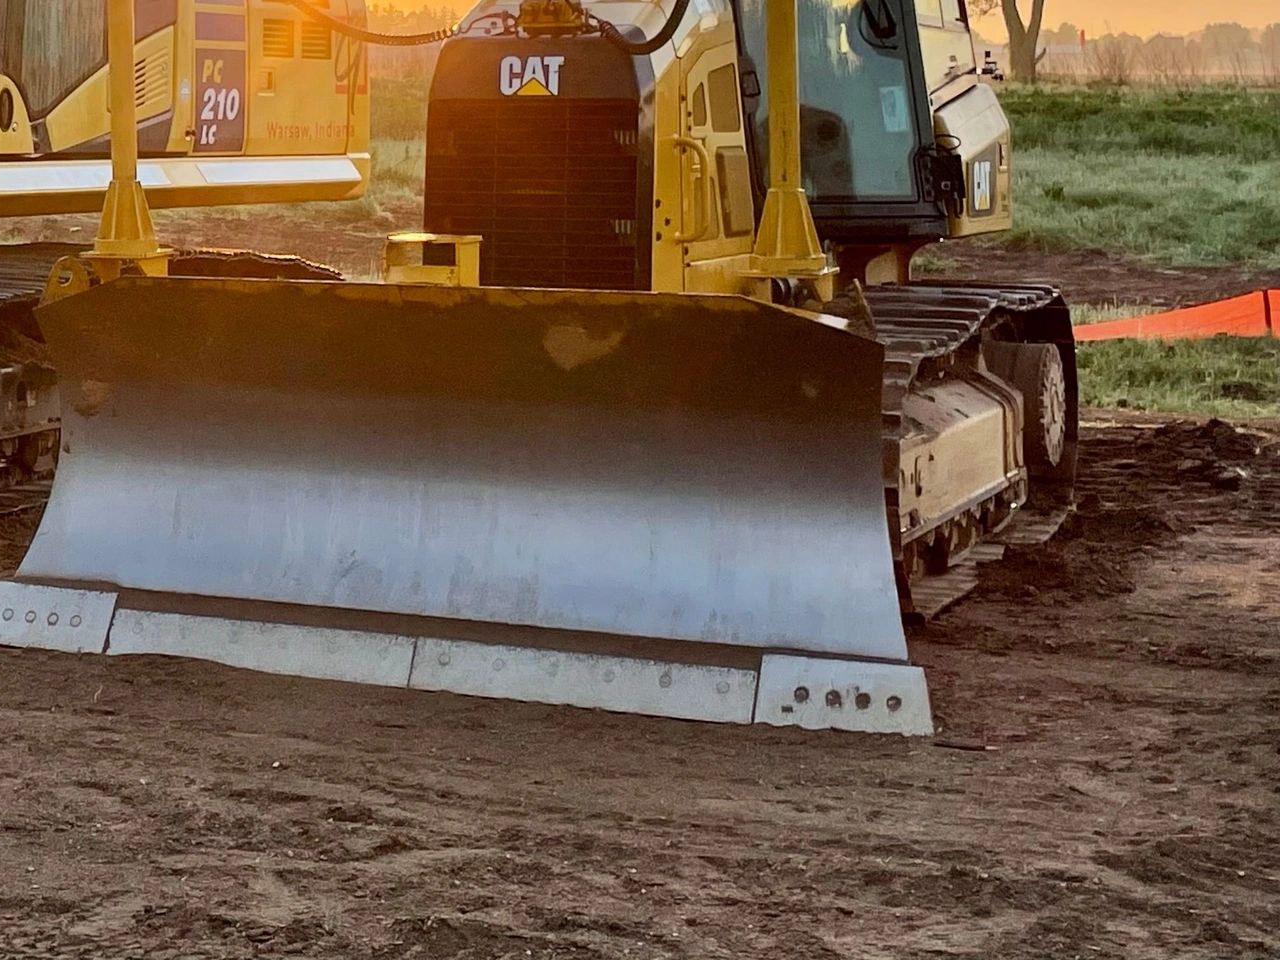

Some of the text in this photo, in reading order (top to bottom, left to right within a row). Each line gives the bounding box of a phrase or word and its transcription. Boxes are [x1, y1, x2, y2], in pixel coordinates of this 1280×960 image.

[202, 58, 224, 84] PC
[500, 55, 565, 96] CAT
[200, 87, 240, 120] 210
[200, 124, 217, 145] LC
[266, 120, 355, 141] Warsaw, Indiana
